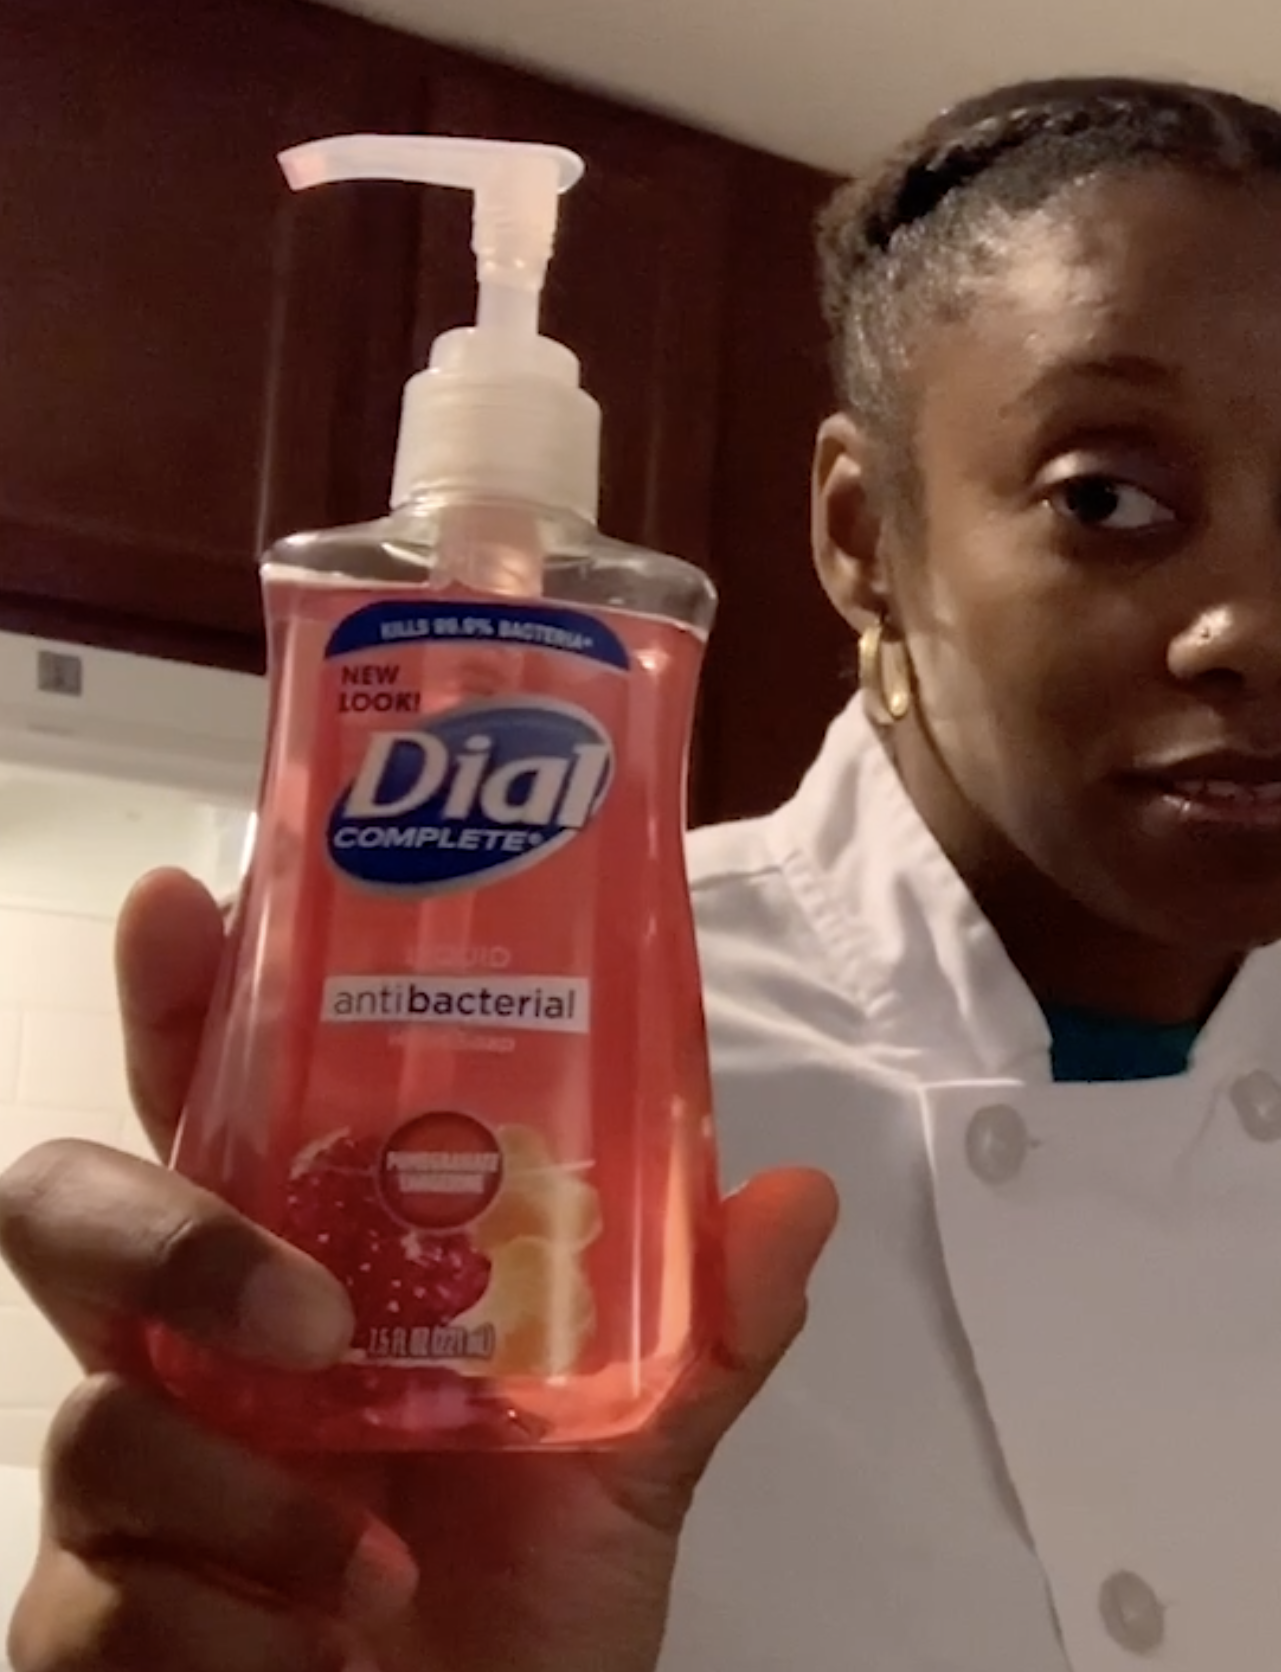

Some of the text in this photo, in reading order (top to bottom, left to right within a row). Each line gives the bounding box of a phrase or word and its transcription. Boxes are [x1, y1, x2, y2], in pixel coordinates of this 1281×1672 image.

[380, 617, 429, 641] KILLS
[341, 665, 401, 686] NEW
[338, 691, 422, 713] LOOK!
[343, 730, 609, 829] Dial
[333, 983, 576, 1020] antibacterial
